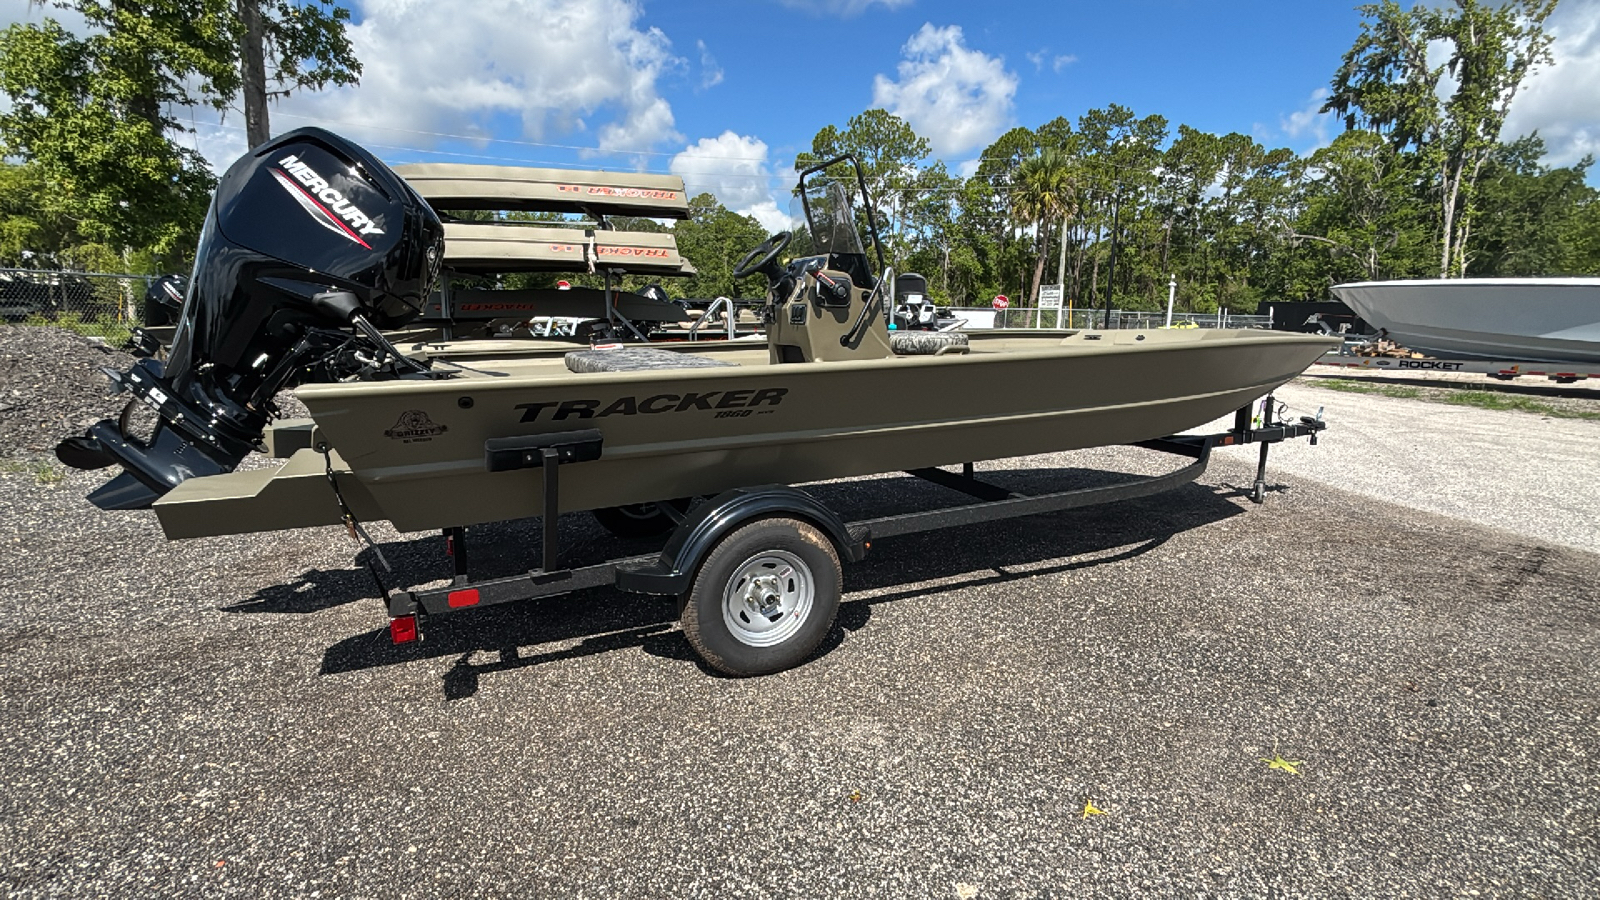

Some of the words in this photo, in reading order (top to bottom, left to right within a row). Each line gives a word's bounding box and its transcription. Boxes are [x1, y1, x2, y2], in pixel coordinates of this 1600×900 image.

[278, 155, 386, 234] MERCURY
[587, 186, 677, 199] TRACKER
[581, 245, 670, 258] TRACKE
[994, 298, 1007, 307] STOP
[1399, 360, 1463, 370] ROCKET
[514, 388, 788, 423] TRACKER
[714, 410, 753, 418] 1860
[397, 428, 435, 436] GRIZZLY
